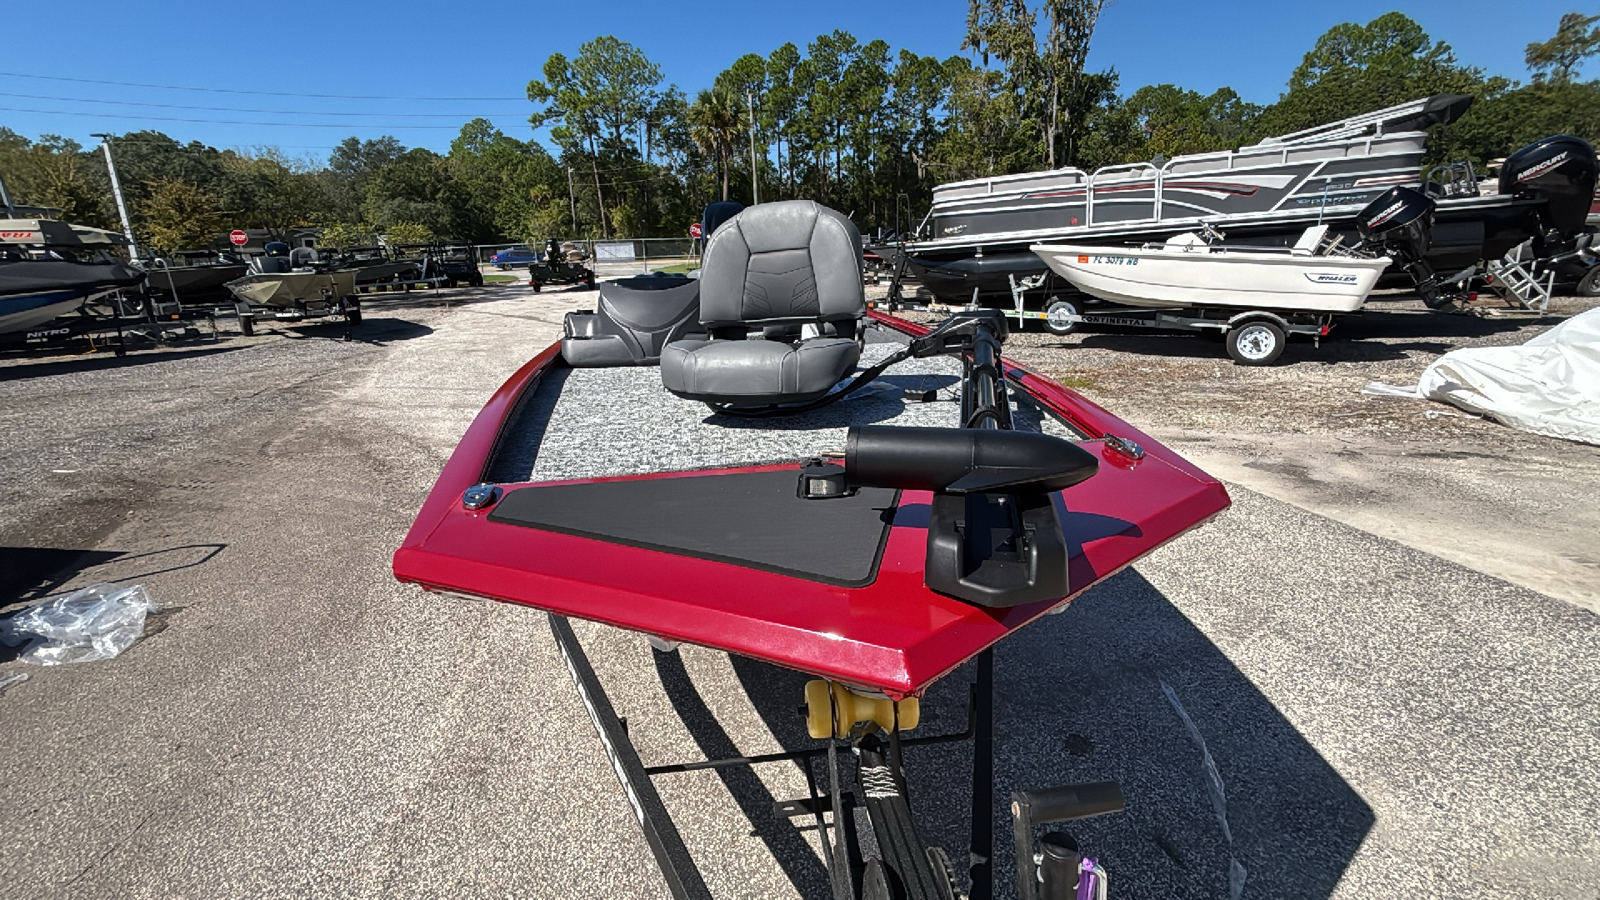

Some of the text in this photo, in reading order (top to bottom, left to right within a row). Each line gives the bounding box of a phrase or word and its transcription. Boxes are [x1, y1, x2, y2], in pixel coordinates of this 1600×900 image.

[1517, 151, 1568, 181] MERCURY
[1367, 200, 1403, 227] MERCURY
[1093, 256, 1102, 264] FL
[1081, 315, 1147, 326] CONTINENTAL
[26, 328, 70, 339] NITRO
